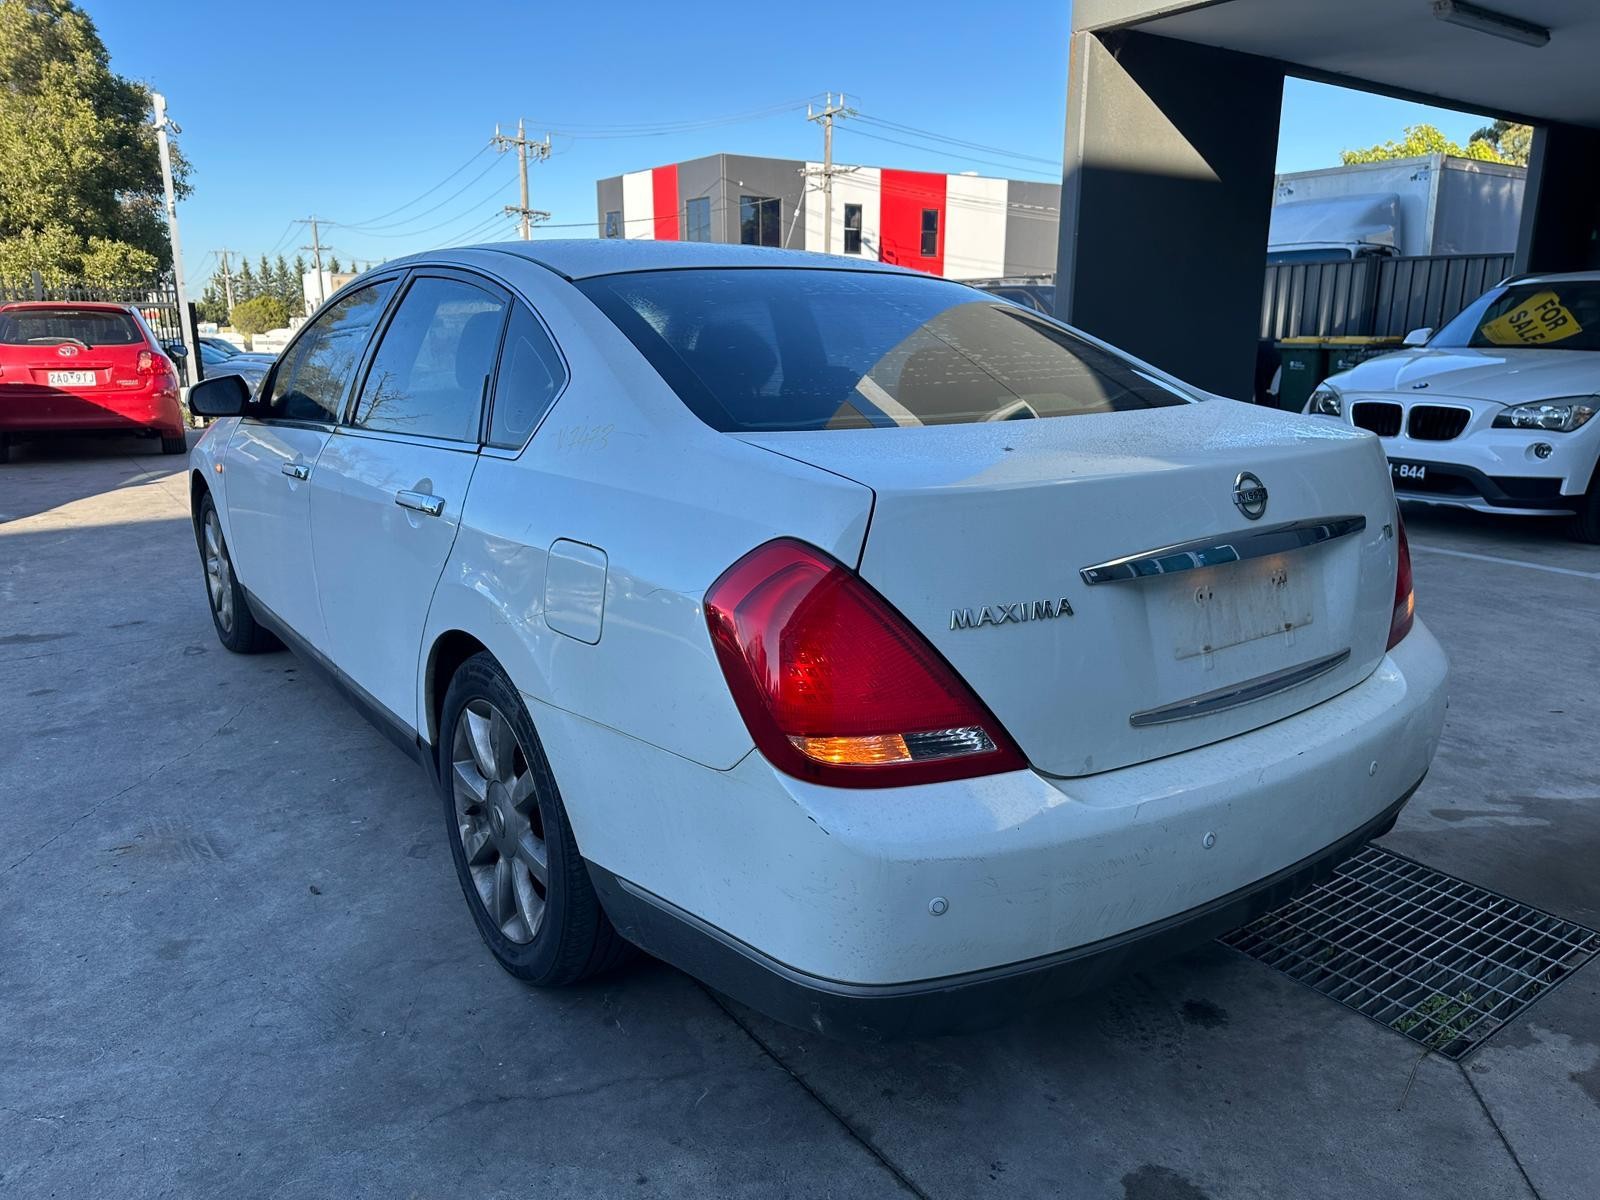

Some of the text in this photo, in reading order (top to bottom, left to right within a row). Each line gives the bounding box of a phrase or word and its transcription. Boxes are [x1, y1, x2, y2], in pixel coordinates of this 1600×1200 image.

[1508, 310, 1546, 344] SALE
[1535, 299, 1568, 332] FOR
[950, 597, 1074, 630] MAXIMA
